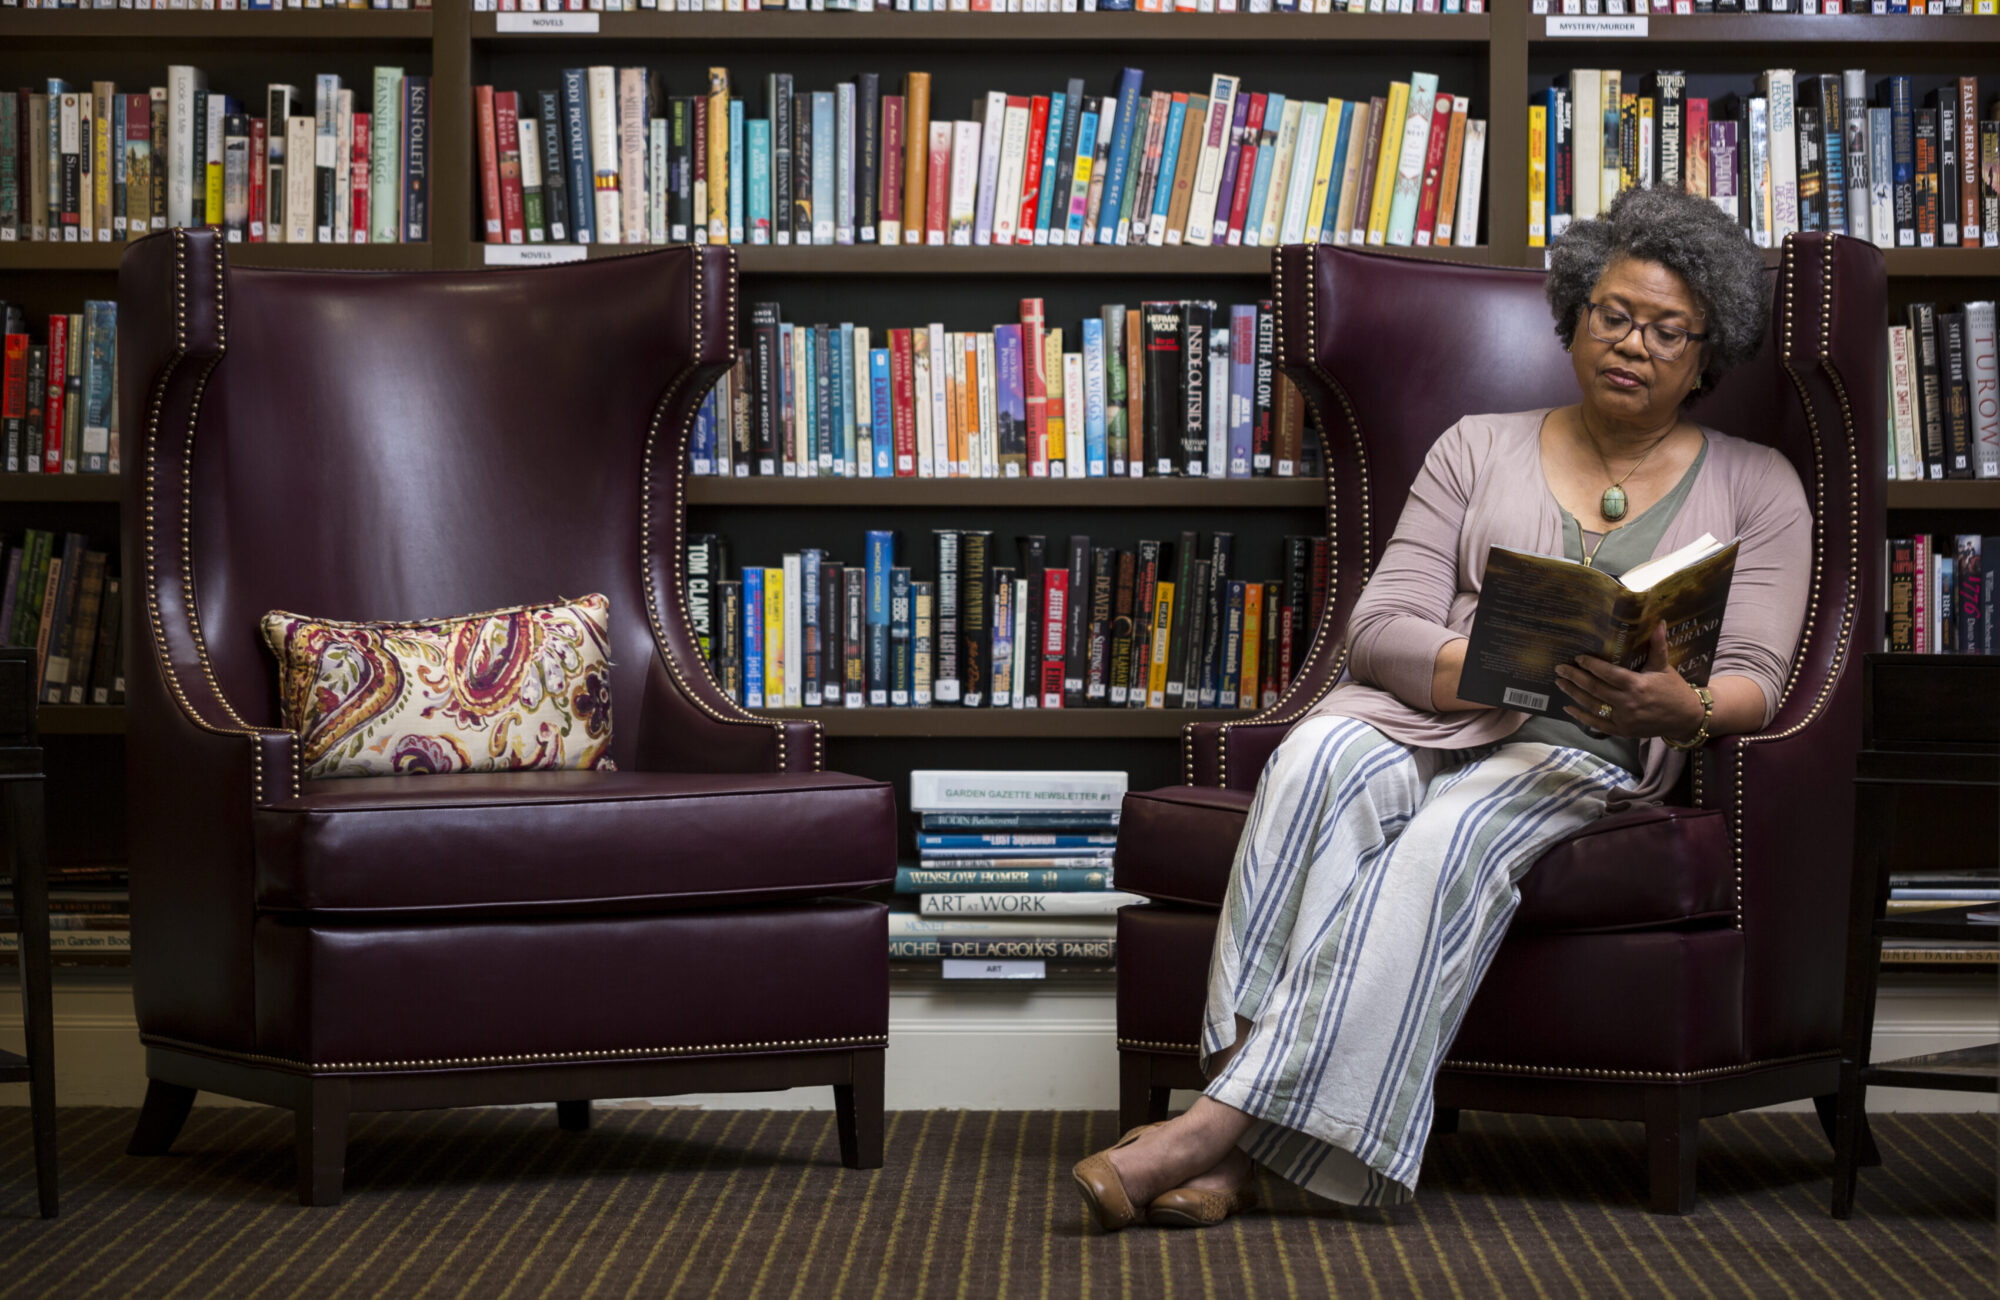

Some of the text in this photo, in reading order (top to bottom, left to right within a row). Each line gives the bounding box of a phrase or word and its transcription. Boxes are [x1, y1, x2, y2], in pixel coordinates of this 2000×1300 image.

[1559, 23, 1635, 31] MYSTERY/MURDER
[177, 76, 188, 100] Look
[1656, 75, 1686, 88] STEPHEN
[1663, 87, 1680, 99] KING
[178, 102, 185, 116] at
[566, 73, 585, 161] JODI PICOULT
[776, 87, 788, 121] CLOUD
[1662, 104, 1681, 129] THE
[1770, 80, 1784, 133] LEONARD
[1780, 83, 1794, 129] ELMORE
[1830, 84, 1841, 130] ELIZABETH
[177, 118, 187, 135] Me
[374, 75, 389, 185] FANNIE FLAGG
[409, 85, 426, 178] KEN FOLLETT
[543, 93, 561, 173] JODI PICOULT
[777, 122, 789, 147] NINE
[1962, 84, 1976, 184] FALSE MERMAID
[1848, 155, 1867, 166] THE
[1848, 166, 1867, 177] BIG
[1944, 151, 1954, 166] ICE
[1108, 156, 1124, 207] LISA SEE
[1849, 177, 1869, 190] LAW
[779, 199, 789, 221] RICE
[1775, 185, 1787, 221] DEAKY
[1785, 181, 1797, 225] FREAKY
[1828, 207, 1845, 225] SIN
[1895, 183, 1906, 223] MURDER
[1904, 183, 1914, 220] CAPITOL
[1147, 314, 1180, 324] HERMAN
[1256, 313, 1273, 408] KEITH ABLOW
[1892, 327, 1906, 364] MARTIN
[1949, 322, 1963, 382] SCOTT TUROW
[760, 343, 769, 391] GENTLEMAN
[831, 348, 843, 408] ANNE TYLER
[1087, 329, 1106, 423] SUSAN WIGGS
[1186, 324, 1203, 433] INSIDE OUTSIDE
[1974, 331, 2000, 447] TUROW
[762, 405, 770, 442] MOSCOW
[819, 388, 831, 455] ANNE TYLE
[1209, 536, 1221, 592] emerson
[1217, 552, 1227, 576] earl
[1916, 542, 1924, 572] PRIDE
[687, 542, 710, 634] TOM CLANCY
[873, 541, 882, 613] MICHAEL CONNELLY
[939, 533, 958, 653] PATRICIA CORNWELL THE LAST
[964, 535, 985, 631] PATRICIA CORNWELL
[1291, 539, 1305, 631] KEN FOLLETT
[1916, 572, 1924, 609] BEFORE
[1093, 575, 1111, 621] DEAVER
[1158, 602, 1170, 628] HEART
[1942, 593, 1952, 618] BIG
[1959, 575, 1982, 619] 1776
[1047, 587, 1064, 652] JEFFERY DEAVER
[1282, 610, 1292, 641] CODE
[1665, 617, 1699, 639] AURA
[1916, 611, 1924, 630] THE
[873, 623, 883, 682] THE LATE SHOW
[1091, 635, 1106, 669] SLEEPING
[1116, 637, 1130, 653] TIM
[1203, 616, 1219, 663] vanishing
[1225, 607, 1241, 674] Janet Evanovich
[1282, 646, 1291, 663] TO
[945, 789, 1112, 801] GARDEN GAZETTE NEWSLETTER #1
[938, 816, 1019, 826] RODIN Rediscovered
[909, 871, 1030, 884] WINSLOW HOMER
[925, 895, 1046, 912] ART AT WORK
[68, 936, 131, 946] Garden Boo
[904, 921, 945, 932] MONET
[888, 941, 1110, 958] MICHEL DELACROIX'S PARIS
[986, 965, 1003, 973] ART
